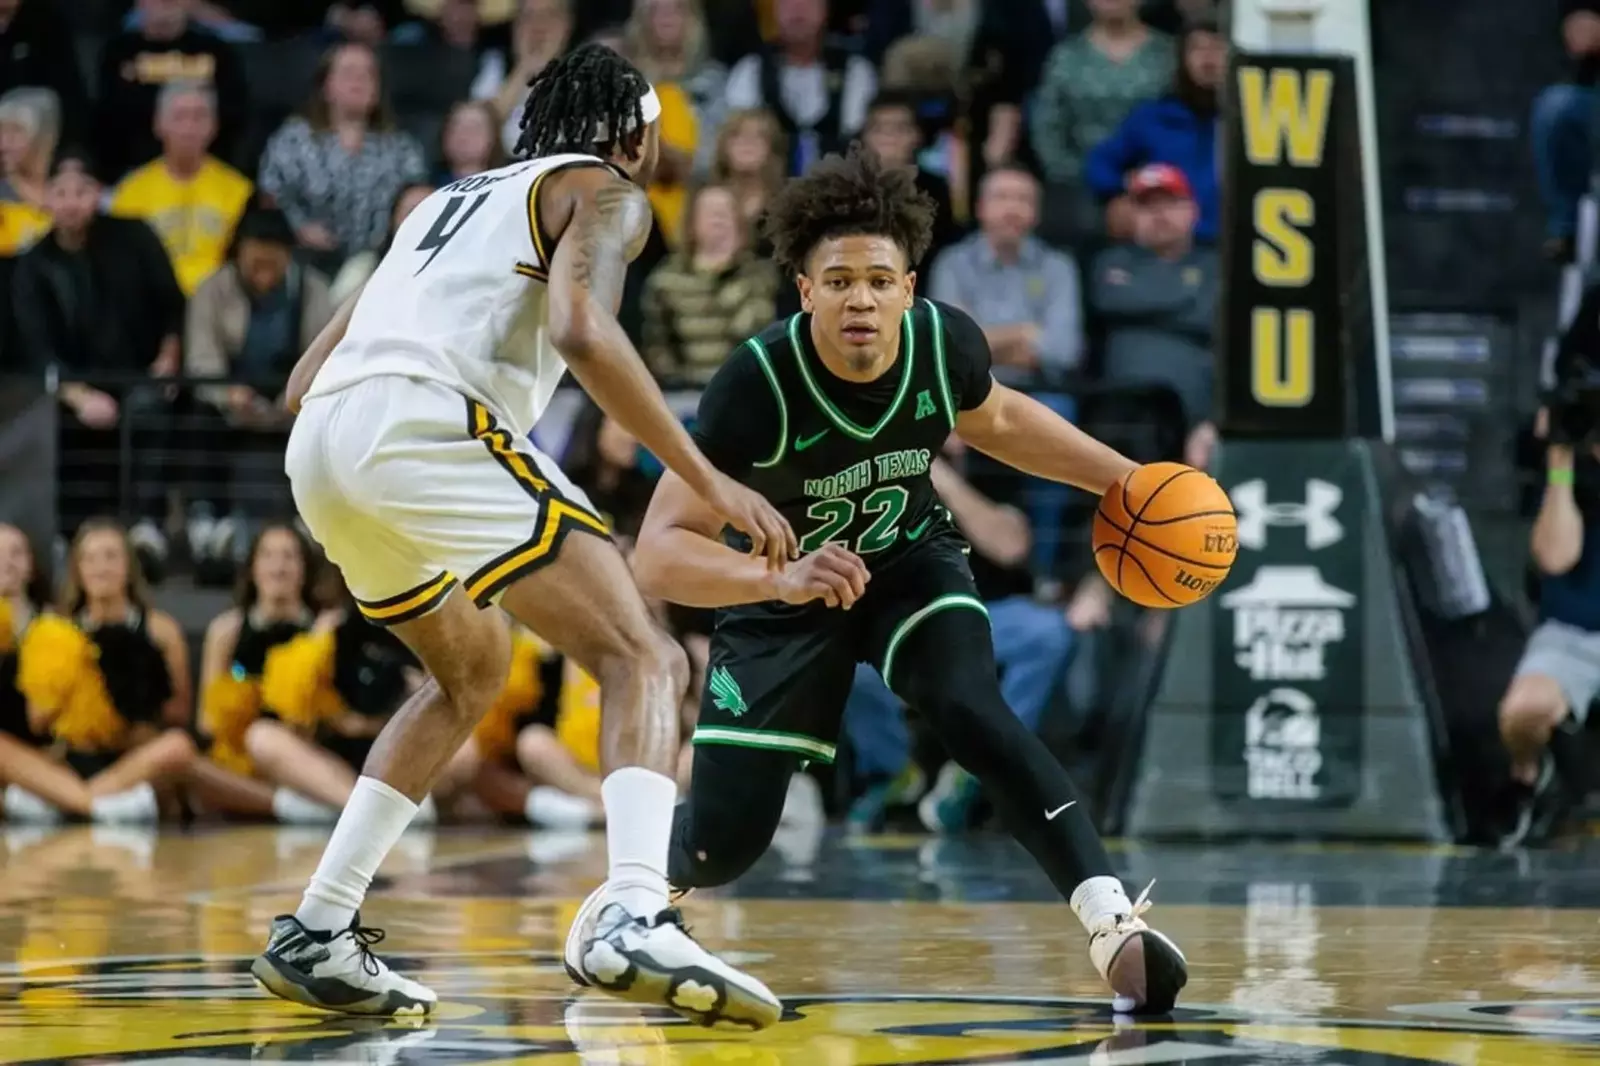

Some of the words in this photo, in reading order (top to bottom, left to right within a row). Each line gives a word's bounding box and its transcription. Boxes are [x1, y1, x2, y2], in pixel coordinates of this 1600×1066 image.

[413, 189, 492, 277] 4
[1238, 67, 1333, 407] WSU
[803, 459, 871, 499] NORTH
[874, 448, 931, 482] TEXAS
[800, 485, 909, 554] 22
